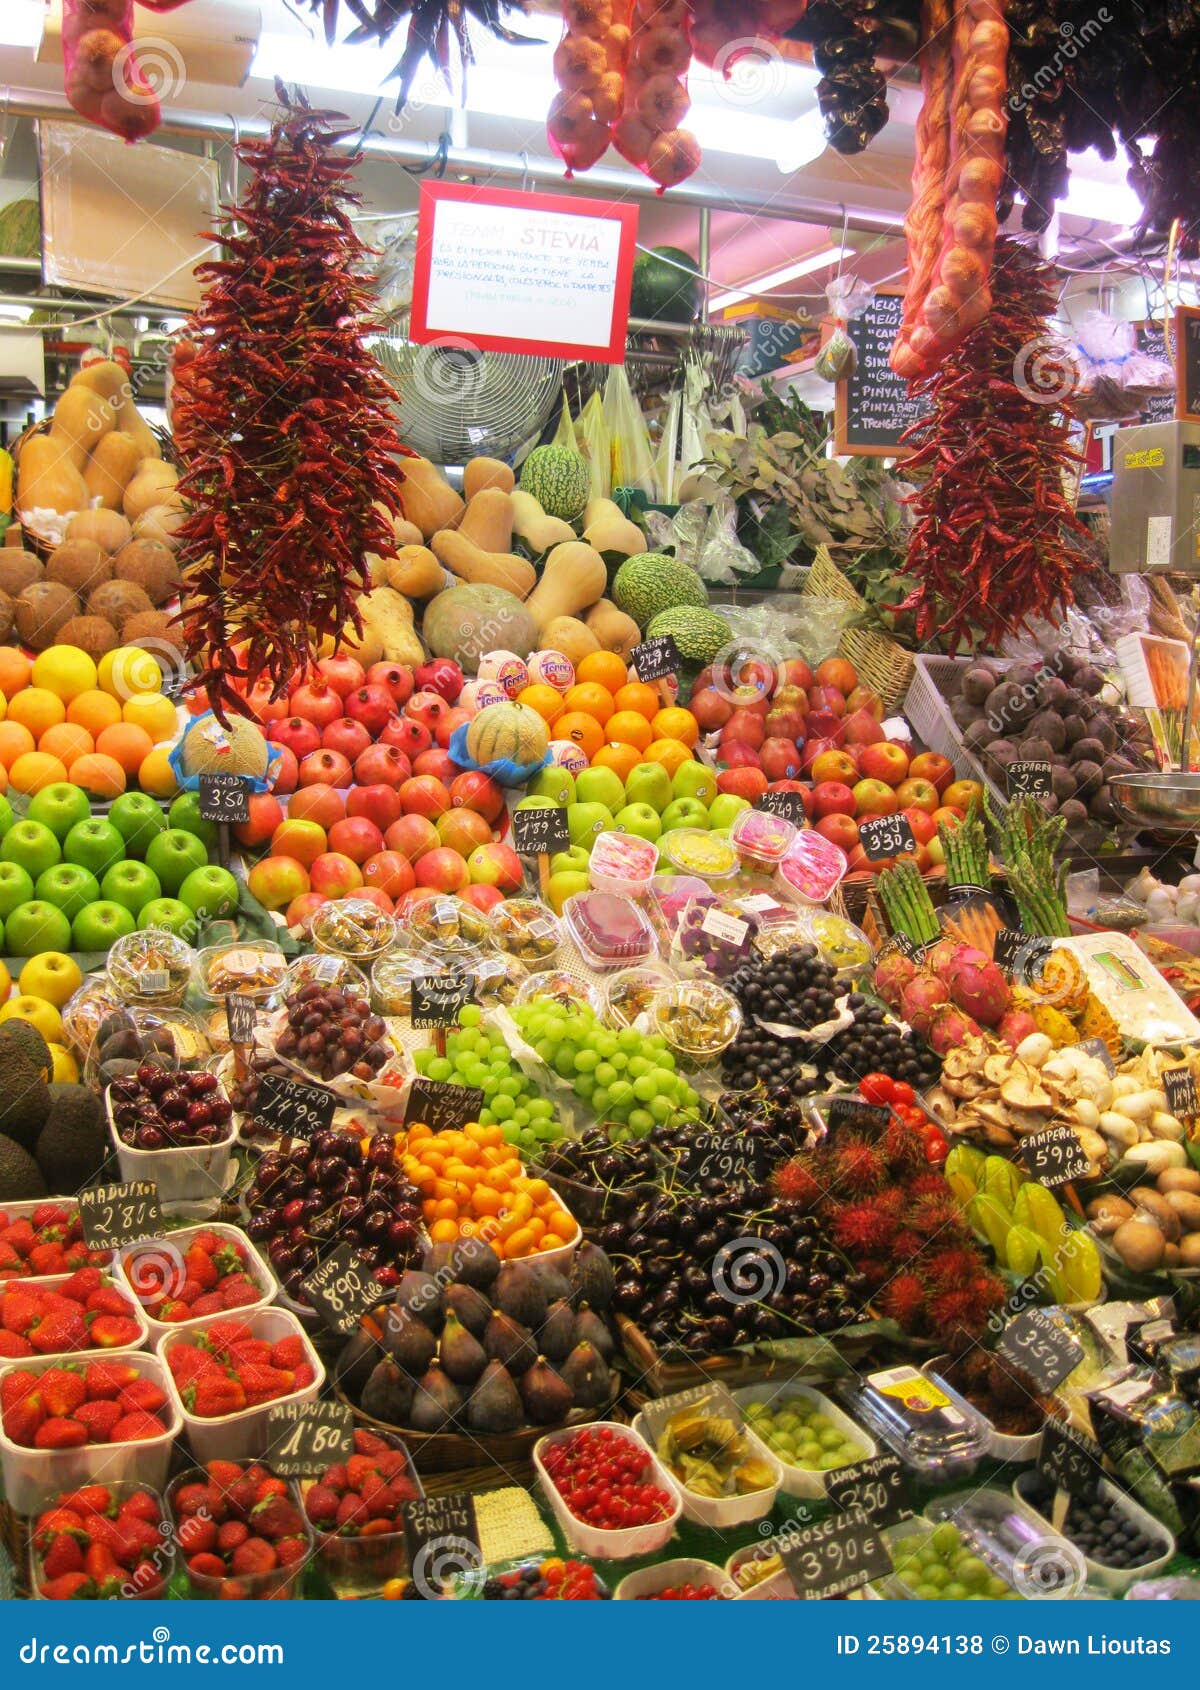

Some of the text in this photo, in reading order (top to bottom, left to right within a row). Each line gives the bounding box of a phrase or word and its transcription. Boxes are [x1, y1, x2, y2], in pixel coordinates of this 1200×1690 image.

[520, 228, 600, 252] STEVIA
[861, 400, 896, 414] PINYA
[209, 788, 244, 808] 3'50
[263, 1076, 329, 1107] CIRERA
[695, 1136, 755, 1154] CIRERA
[800, 1536, 858, 1581] 3'90
